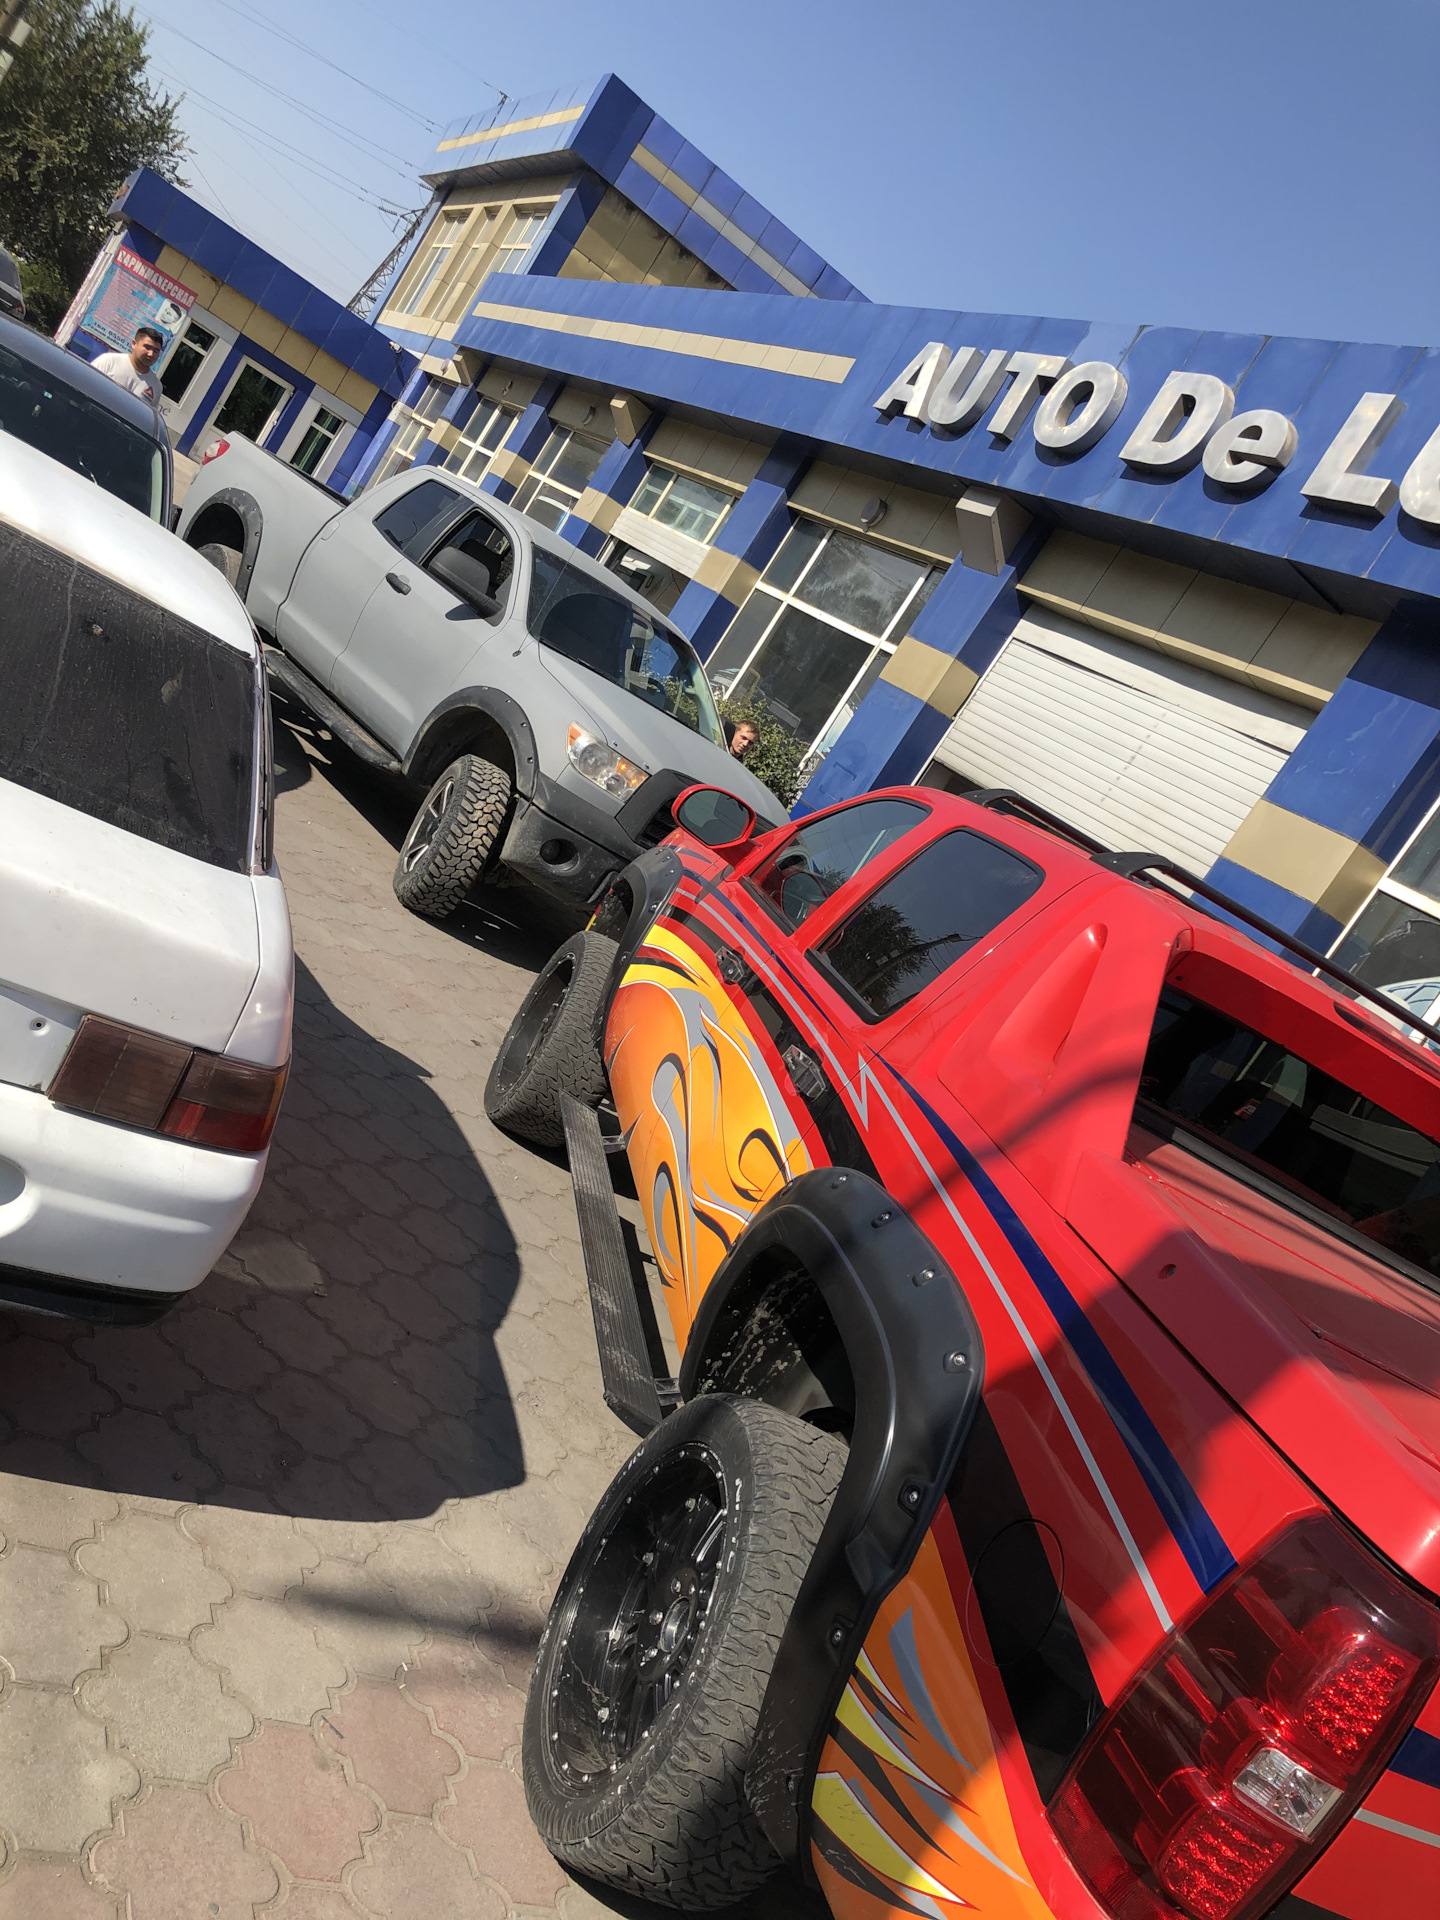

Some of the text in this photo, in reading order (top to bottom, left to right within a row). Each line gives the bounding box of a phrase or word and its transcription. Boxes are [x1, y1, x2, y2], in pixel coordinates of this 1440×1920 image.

[116, 249, 195, 308] ПАРИКМАХЕРСКАЯ
[873, 341, 1129, 456] AUTO
[1118, 370, 1298, 490] De
